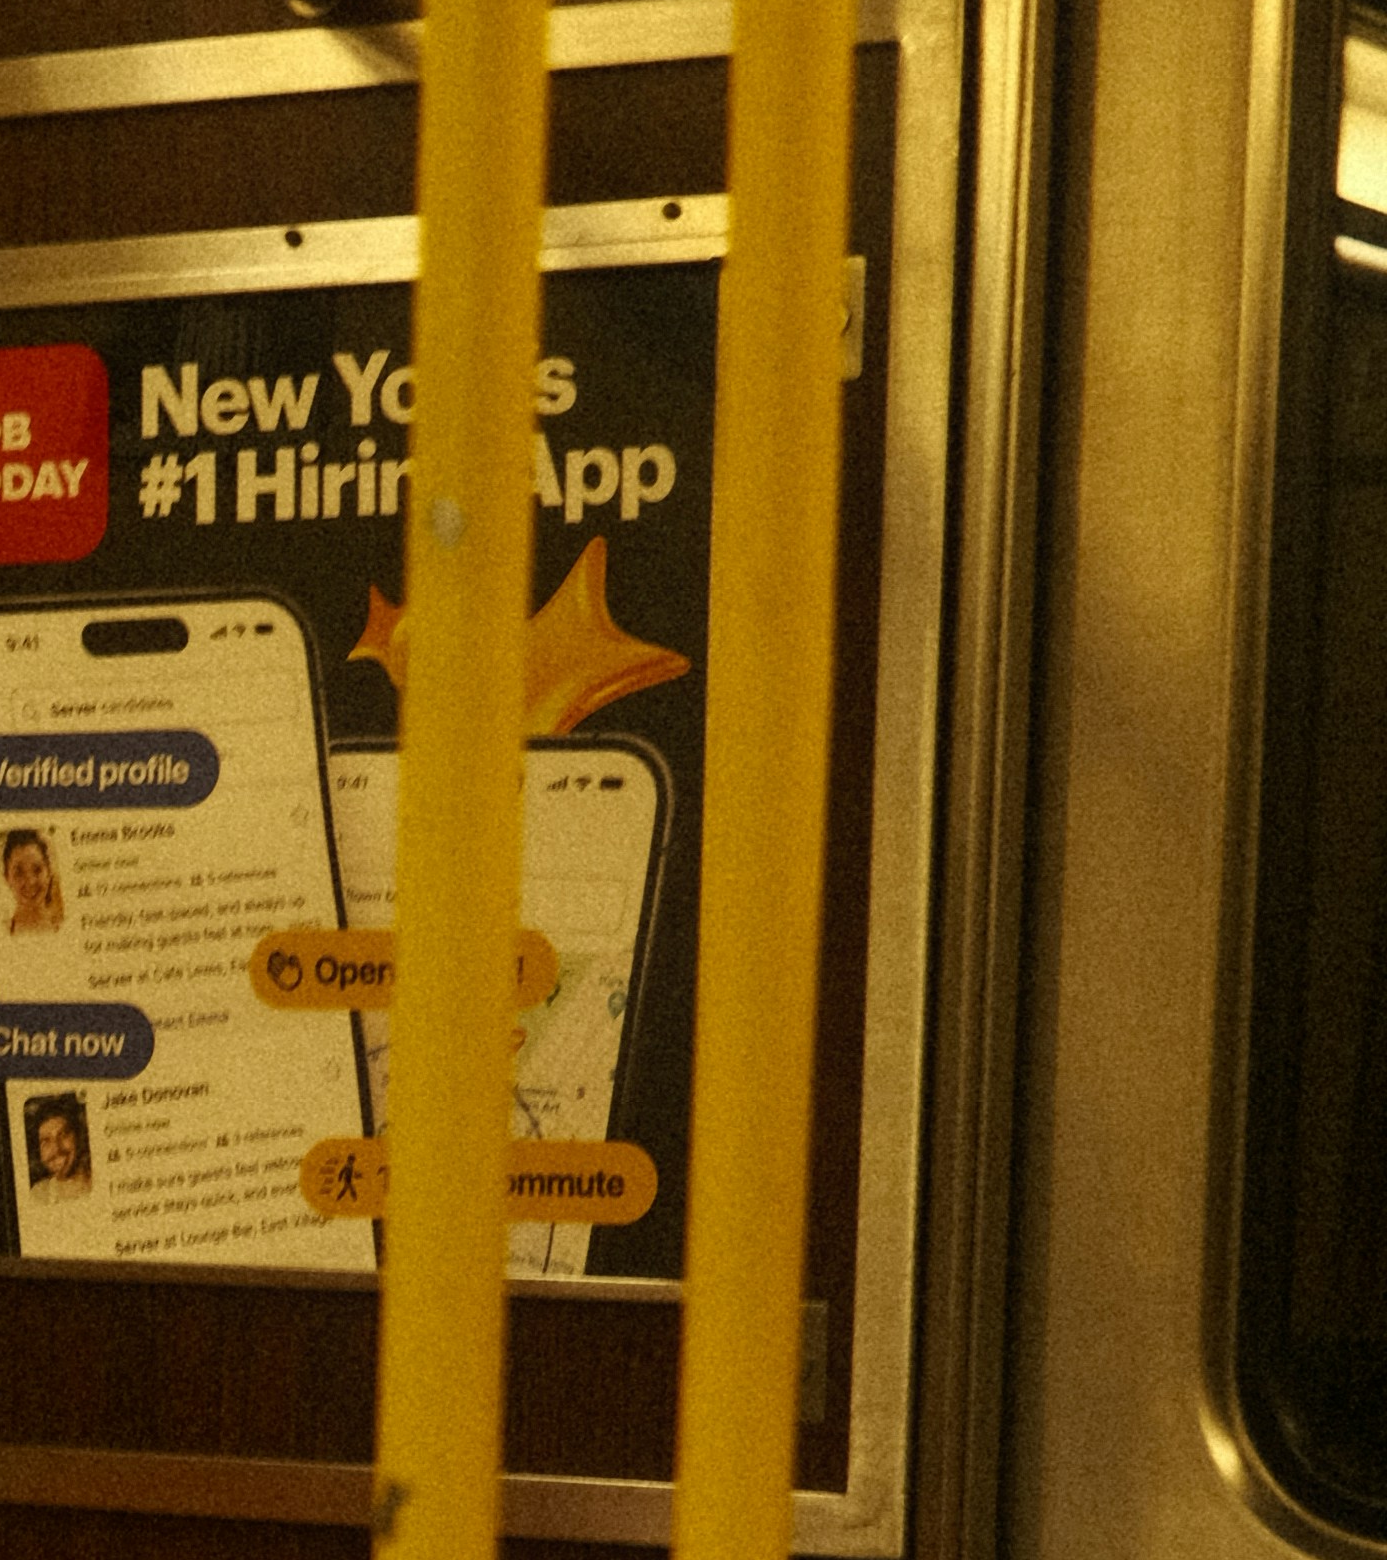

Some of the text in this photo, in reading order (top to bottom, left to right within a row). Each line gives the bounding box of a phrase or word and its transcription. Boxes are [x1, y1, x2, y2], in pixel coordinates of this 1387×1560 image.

[141, 348, 577, 440] New Yos
[138, 450, 217, 526] #1
[234, 437, 414, 524] Hirin
[98, 752, 191, 792] profile
[63, 1031, 127, 1058] now
